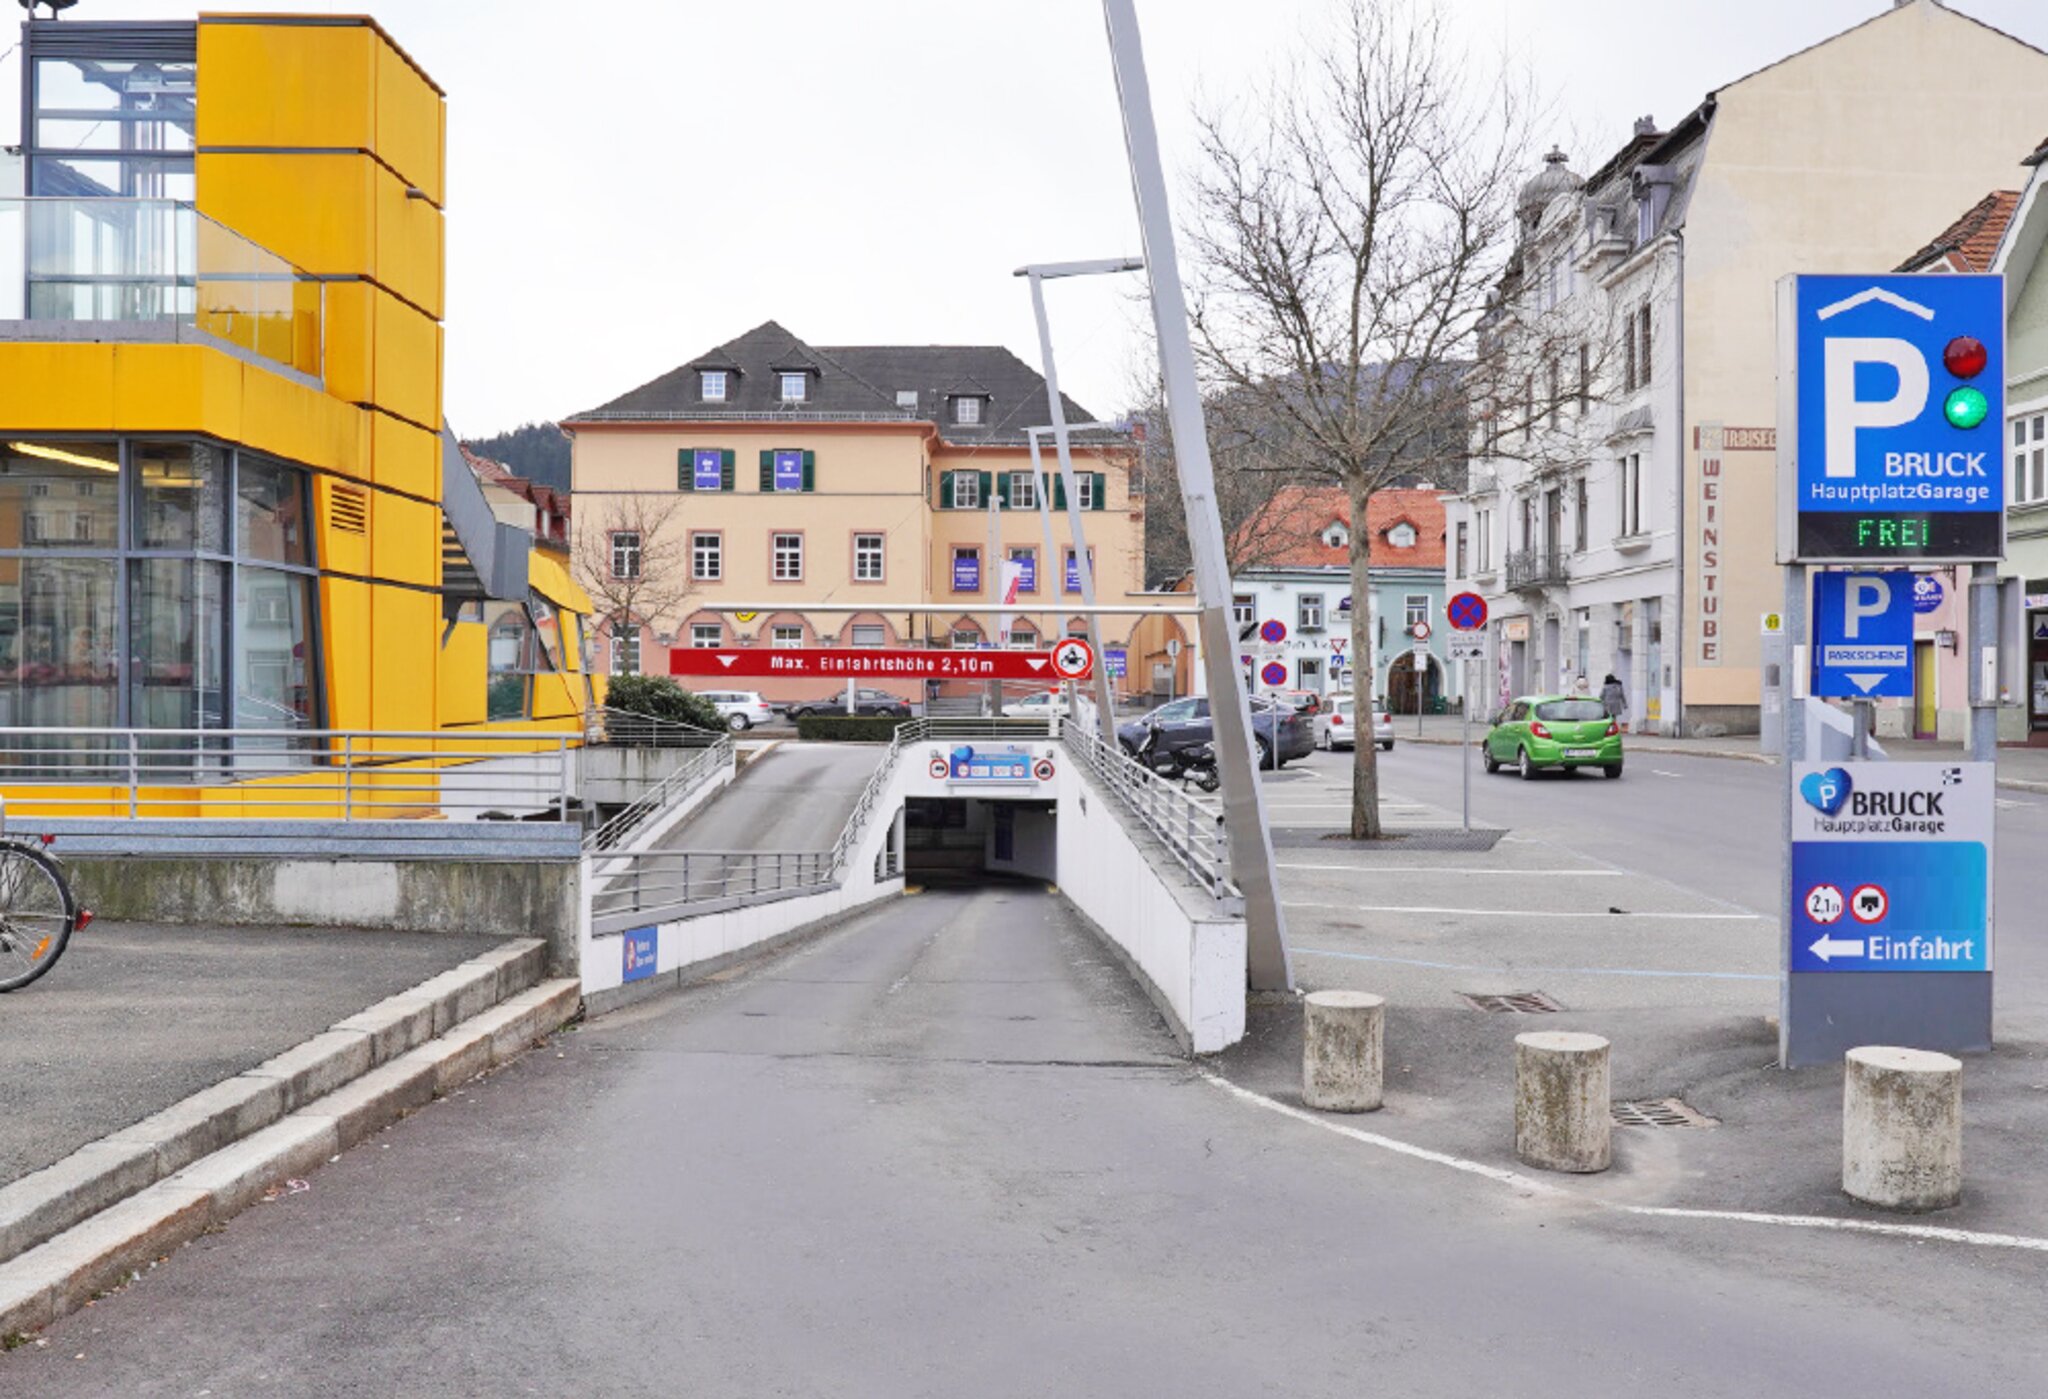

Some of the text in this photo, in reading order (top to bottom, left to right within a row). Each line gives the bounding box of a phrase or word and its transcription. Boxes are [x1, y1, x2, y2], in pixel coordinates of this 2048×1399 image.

[1824, 337, 1930, 478] P
[1884, 452, 1987, 477] BRUCK
[1811, 482, 1989, 504] HauptplatzGarage
[1857, 519, 1930, 547] FREI
[1702, 458, 1720, 661] WEINSTUBE
[1844, 576, 1891, 639] P
[771, 656, 994, 674] Max. Einfahrtshöhe 2,10m
[1819, 785, 1837, 808] P
[1852, 791, 1945, 816] BRUCK
[1814, 818, 1945, 835] HauptplatzGarage
[1868, 936, 1975, 961] Einfahrt
